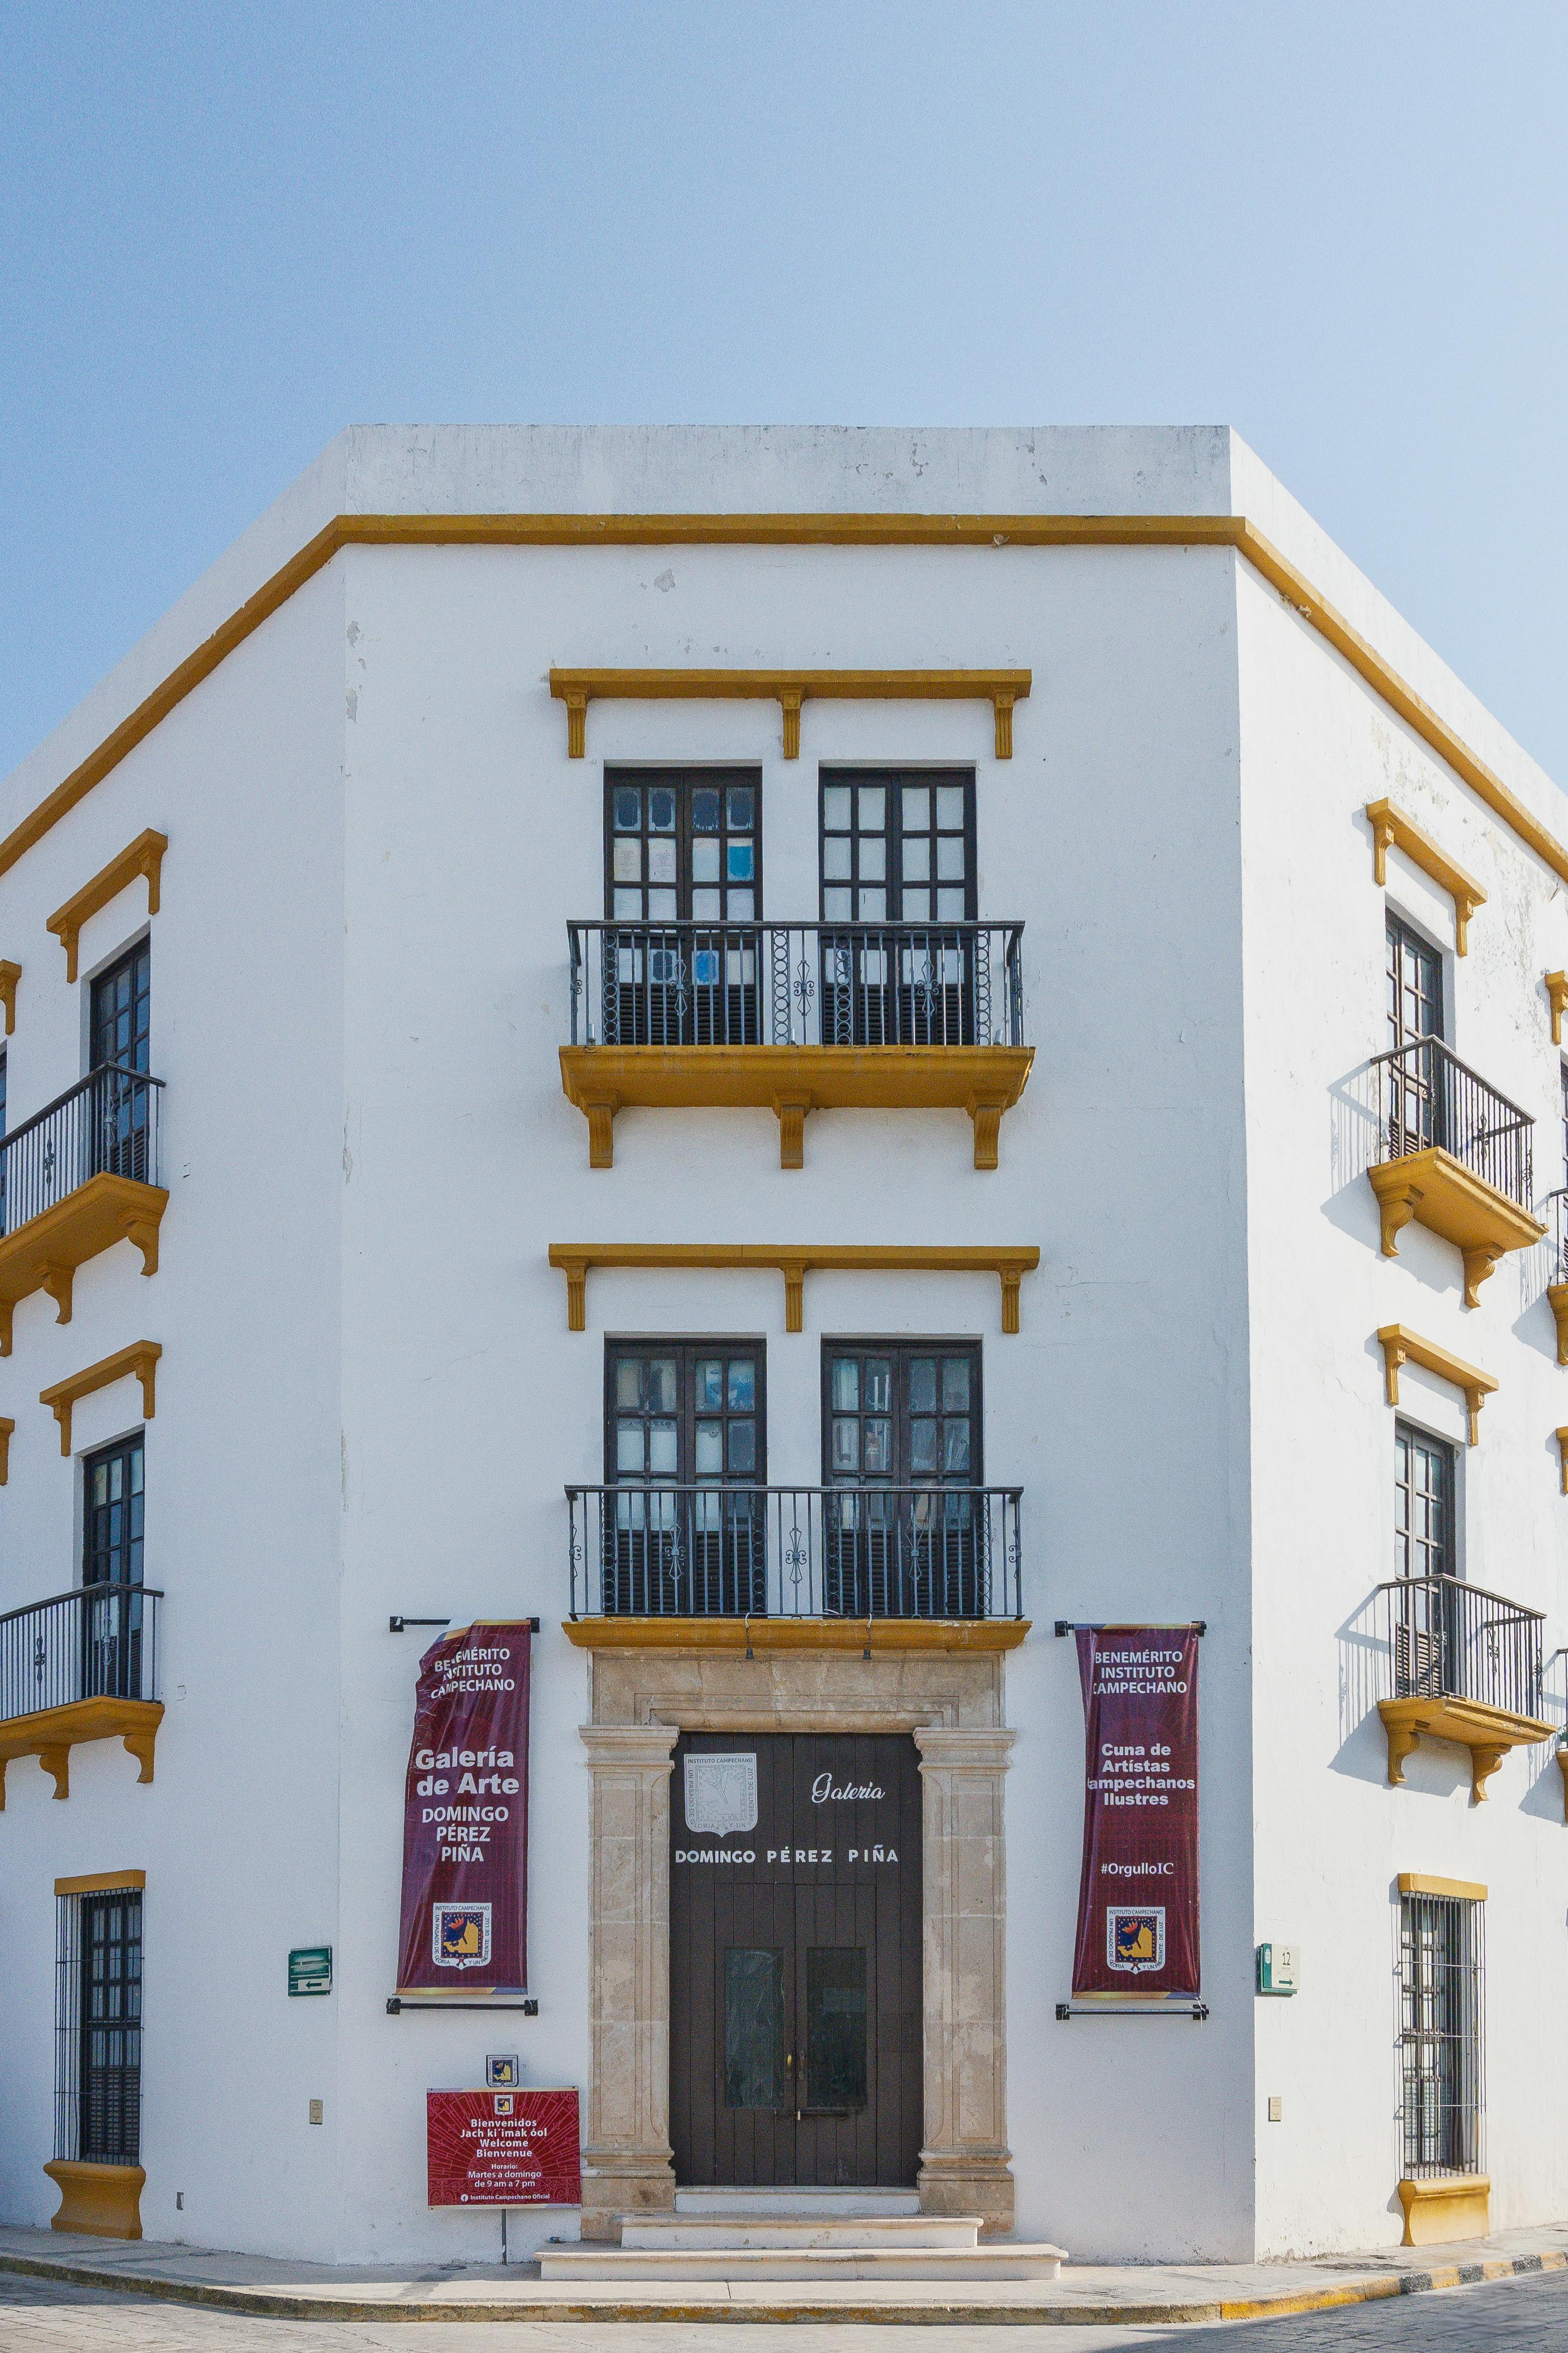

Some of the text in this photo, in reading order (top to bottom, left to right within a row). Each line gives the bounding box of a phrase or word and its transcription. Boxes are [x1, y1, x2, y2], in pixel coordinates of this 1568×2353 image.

[1095, 1649, 1183, 1664] BENEMÉRITO
[1101, 1666, 1175, 1679] INSTITUTO
[1102, 1743, 1171, 1756] Cuna de
[415, 1746, 514, 1770] Galería
[1102, 1760, 1170, 1772] Artístas
[688, 1769, 693, 1779] UN
[416, 1773, 519, 1797] de Arte
[748, 1782, 754, 1790] DE
[1087, 1776, 1196, 1792] ampechanos
[1104, 1793, 1169, 1806] Ilustres
[422, 1806, 509, 1823] DOMINGO
[689, 1808, 695, 1818] DE
[690, 1820, 715, 1829] GLORIA
[436, 1824, 491, 1842] PÉREZ
[441, 1844, 484, 1862] PIÑA
[675, 1844, 899, 1863] DOMINGO PÉREZ PIÑA
[1101, 1862, 1174, 1877] #OrgulloIC
[1109, 1918, 1114, 1927] UN
[480, 1938, 489, 1964] PRESENTE
[1154, 1943, 1163, 1969] PRESENTE
[435, 1955, 450, 1965] GLORIA
[1109, 1959, 1125, 1969] GLORIA
[1282, 1952, 1291, 1966] 12
[470, 2118, 537, 2127] Bienvenidos
[460, 2129, 484, 2138] Jach
[530, 2128, 547, 2137] óol
[479, 2138, 529, 2148] Welcome
[476, 2149, 532, 2158] Bienvenue
[504, 2170, 542, 2179] domingo
